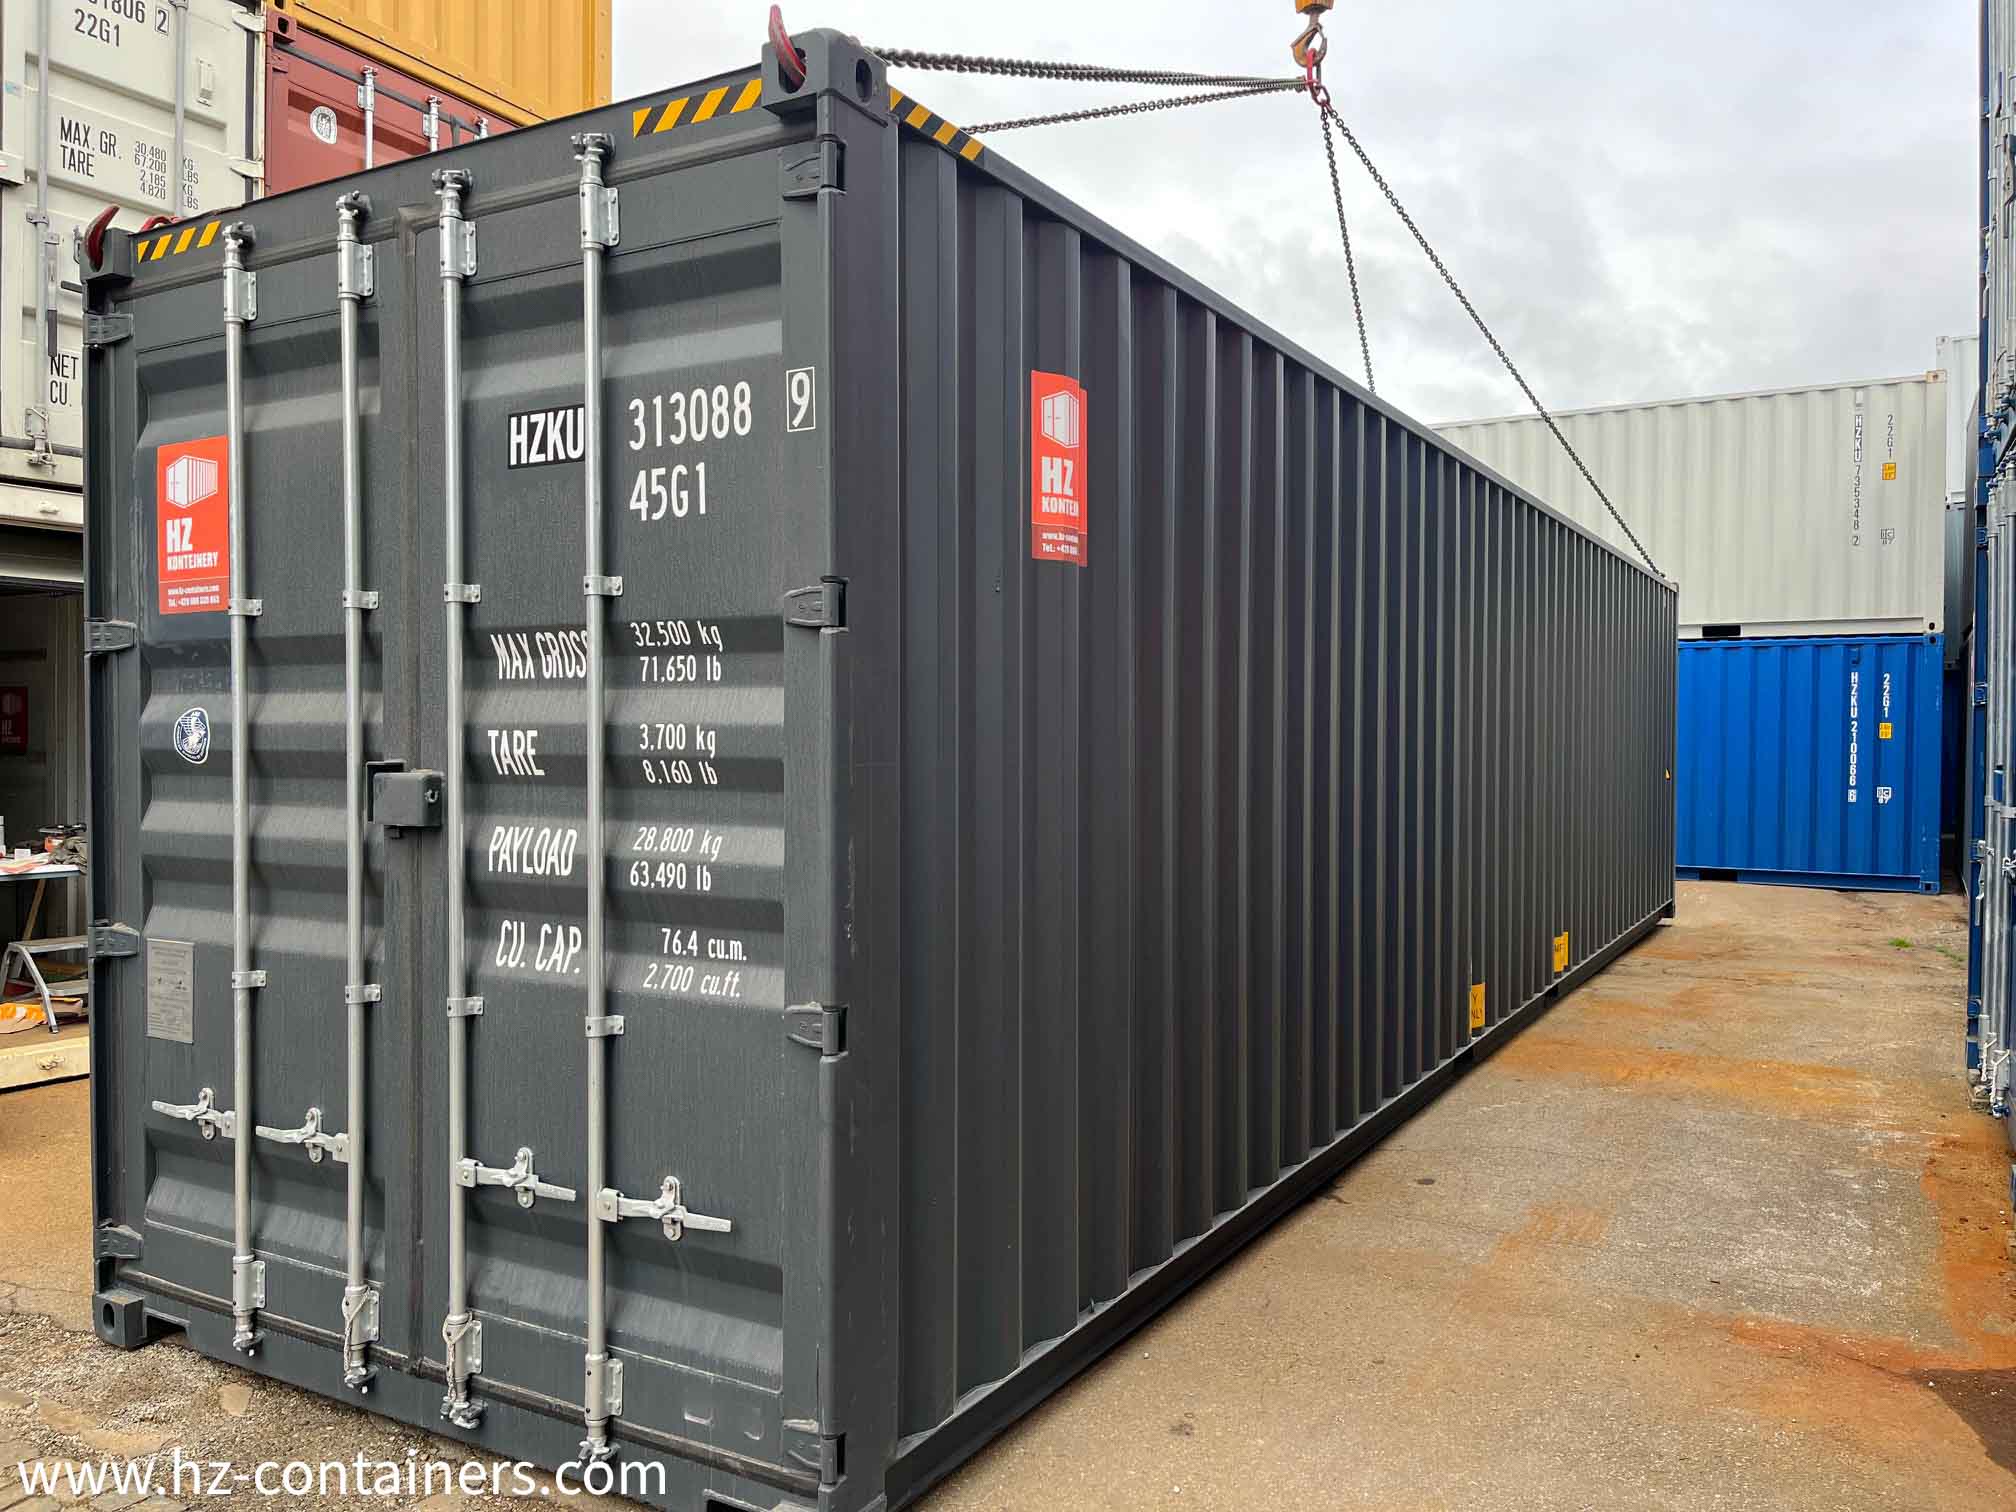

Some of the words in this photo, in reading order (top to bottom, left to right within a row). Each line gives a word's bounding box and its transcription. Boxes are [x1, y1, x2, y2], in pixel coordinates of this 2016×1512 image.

[74, 8, 120, 47] 22G1
[157, 10, 168, 33] 2
[60, 116, 96, 152] MAX.
[100, 130, 122, 160] GR.
[60, 144, 95, 178] TARE
[50, 353, 79, 380] NET
[50, 380, 73, 407] CU.
[510, 407, 585, 466] HZKU
[628, 381, 752, 451] 313088
[791, 371, 811, 428] 9
[629, 462, 706, 521] 45G1
[1041, 456, 1074, 497] HZ
[166, 517, 193, 553] HZ
[490, 632, 536, 680] MAX
[696, 620, 723, 653] kg
[706, 655, 722, 682] lb
[1850, 671, 1859, 718] HZKU
[1883, 673, 1891, 719] 22G1
[487, 729, 545, 776] TARE
[696, 724, 716, 759] kg
[699, 761, 719, 785] lb
[488, 826, 578, 876] PAYLOAD
[699, 830, 723, 861] kg
[696, 864, 712, 892] lb
[495, 919, 526, 969] CU.
[534, 923, 582, 975] CAP.
[661, 927, 698, 957] 76.4
[707, 938, 748, 961] cu.m.
